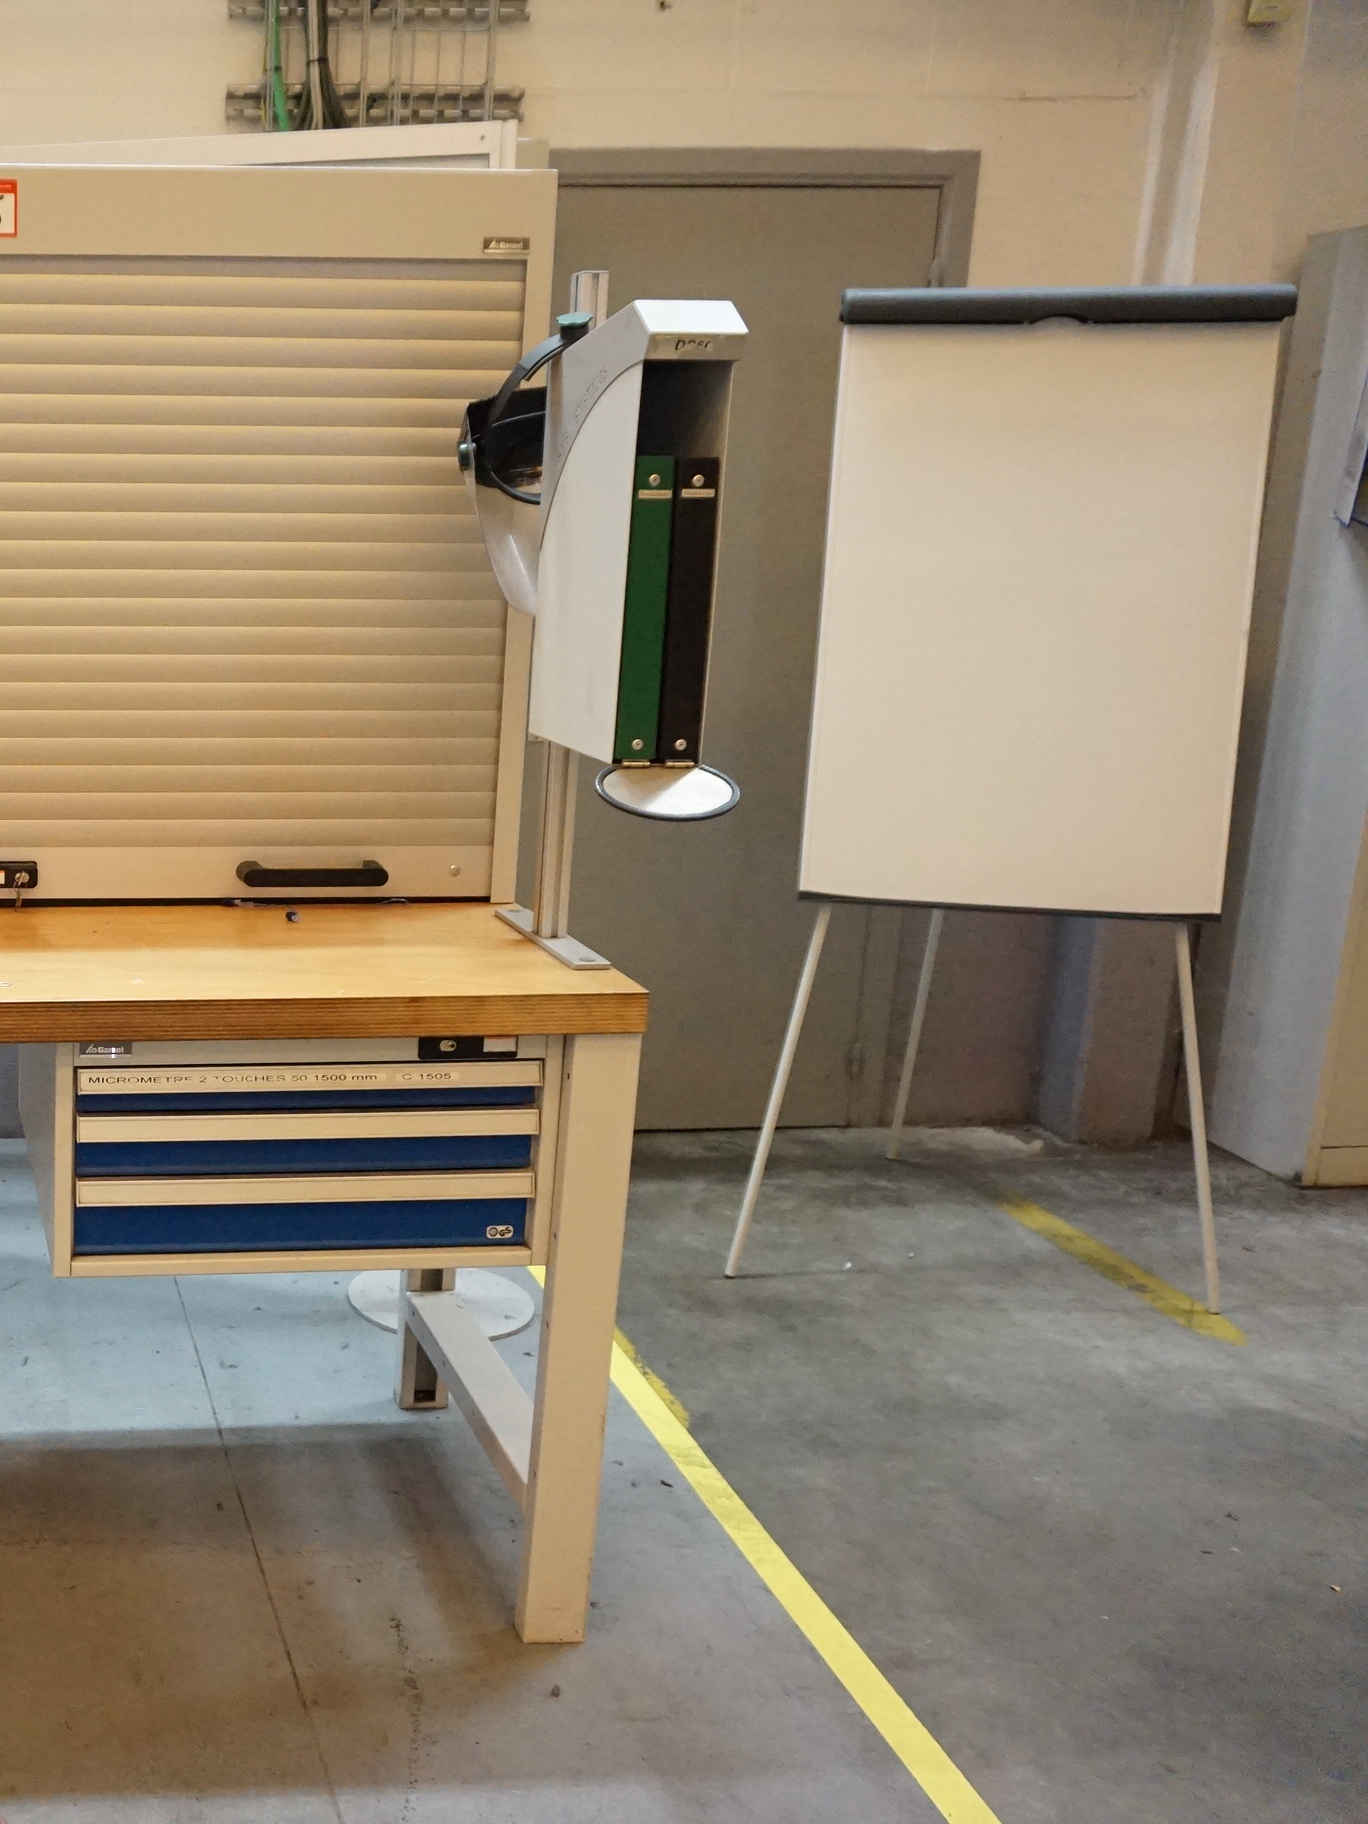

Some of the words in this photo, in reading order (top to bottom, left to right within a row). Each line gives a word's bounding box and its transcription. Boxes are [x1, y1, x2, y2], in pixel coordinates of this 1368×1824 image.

[199, 1075, 207, 1083] 2
[291, 1074, 308, 1082] 50
[314, 1074, 347, 1082] 1500
[402, 1073, 413, 1081] C
[418, 1072, 452, 1080] 1505
